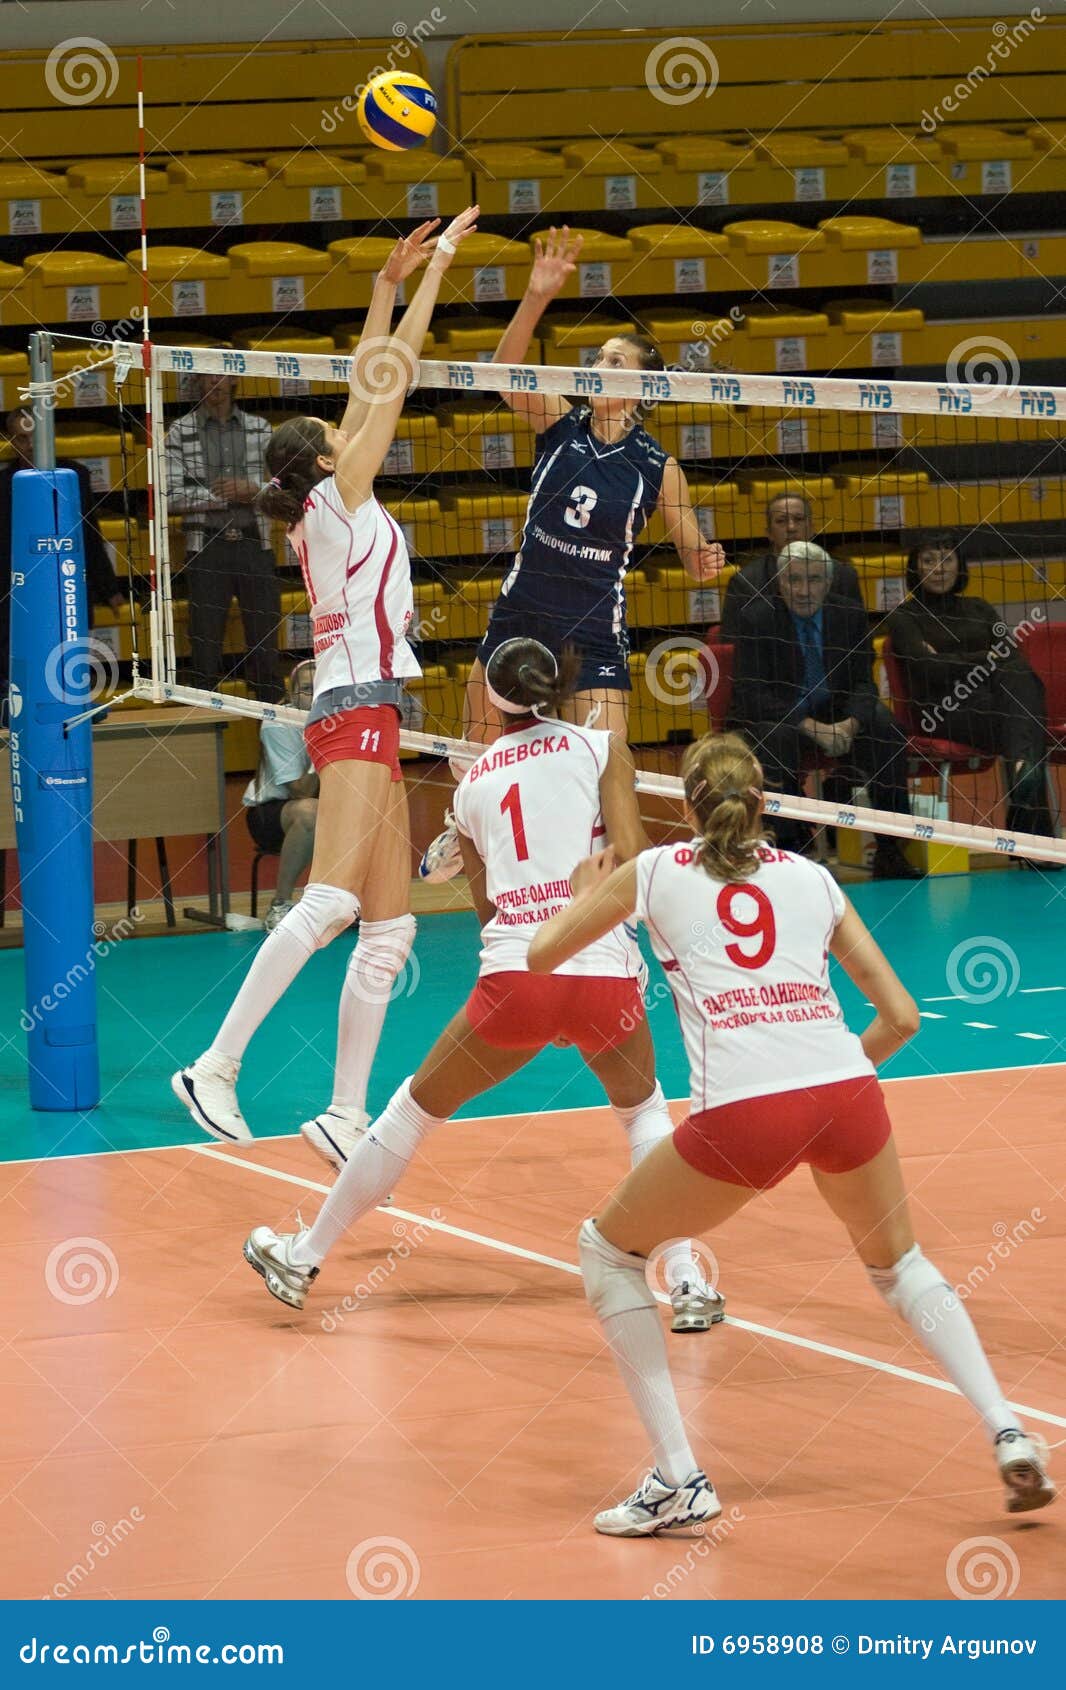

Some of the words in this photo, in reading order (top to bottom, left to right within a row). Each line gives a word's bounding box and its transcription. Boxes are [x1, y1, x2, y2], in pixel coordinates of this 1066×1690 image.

[171, 350, 194, 370] FIVB
[222, 353, 246, 373] FIVB
[275, 356, 300, 376] FIVB
[447, 365, 474, 386] FIVB
[508, 368, 538, 390] FIVB
[573, 371, 603, 394] FIVB
[640, 374, 671, 398] FIVB
[709, 378, 741, 401] FIVB
[782, 380, 815, 405] FIVB
[858, 384, 892, 408] FIVB
[937, 387, 972, 412] FIVB
[1019, 391, 1056, 416] FIVB
[564, 485, 598, 529] 3
[37, 538, 73, 551] FIVB
[63, 578, 78, 642] Senoh
[361, 728, 381, 752] 11
[470, 735, 570, 784] ВАЛЕВСКА
[11, 732, 24, 823] Senoh
[500, 782, 529, 862] 1
[496, 879, 574, 909] РЕЧЬЕ-ОДИНЦ
[717, 884, 776, 970] 9
[786, 1005, 836, 1023] ОБЛАСТЬ
